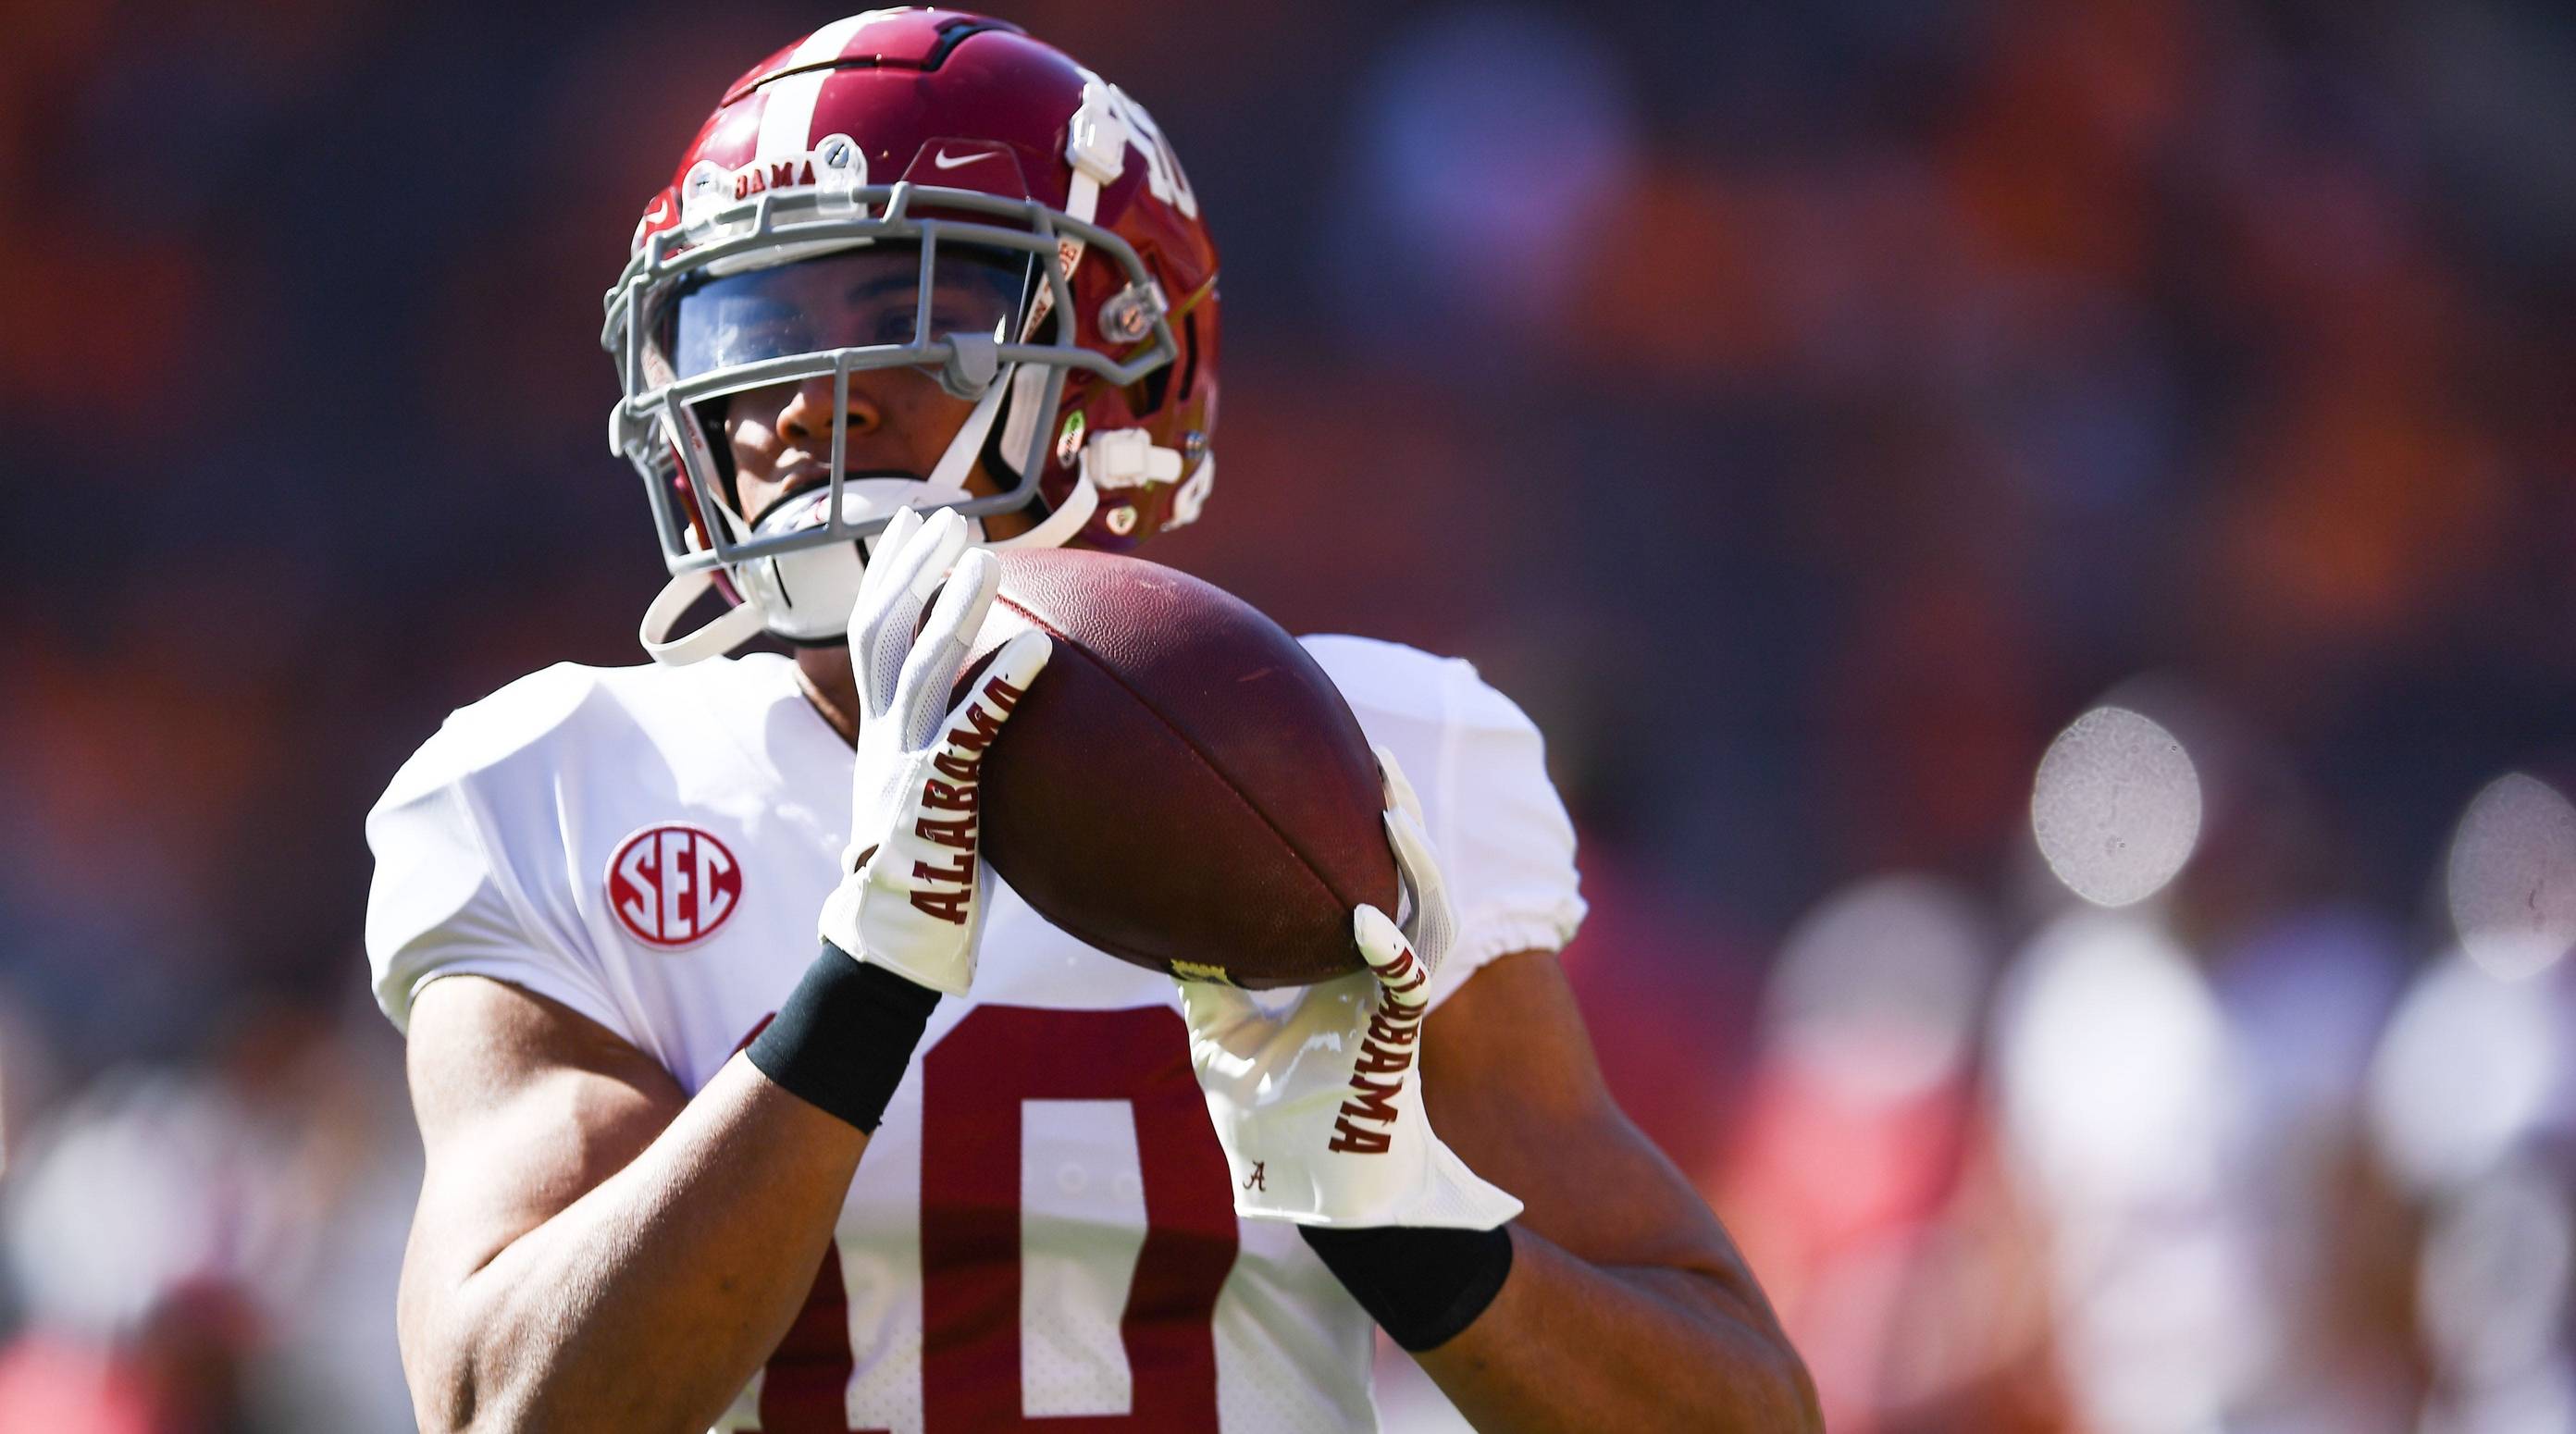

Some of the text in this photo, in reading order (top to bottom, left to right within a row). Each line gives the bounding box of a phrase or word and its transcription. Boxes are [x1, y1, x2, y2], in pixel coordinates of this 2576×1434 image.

[735, 160, 816, 201] BAMA
[910, 676, 1025, 925] ALABAMA
[618, 832, 732, 940] SEC
[1243, 1160, 1267, 1192] A
